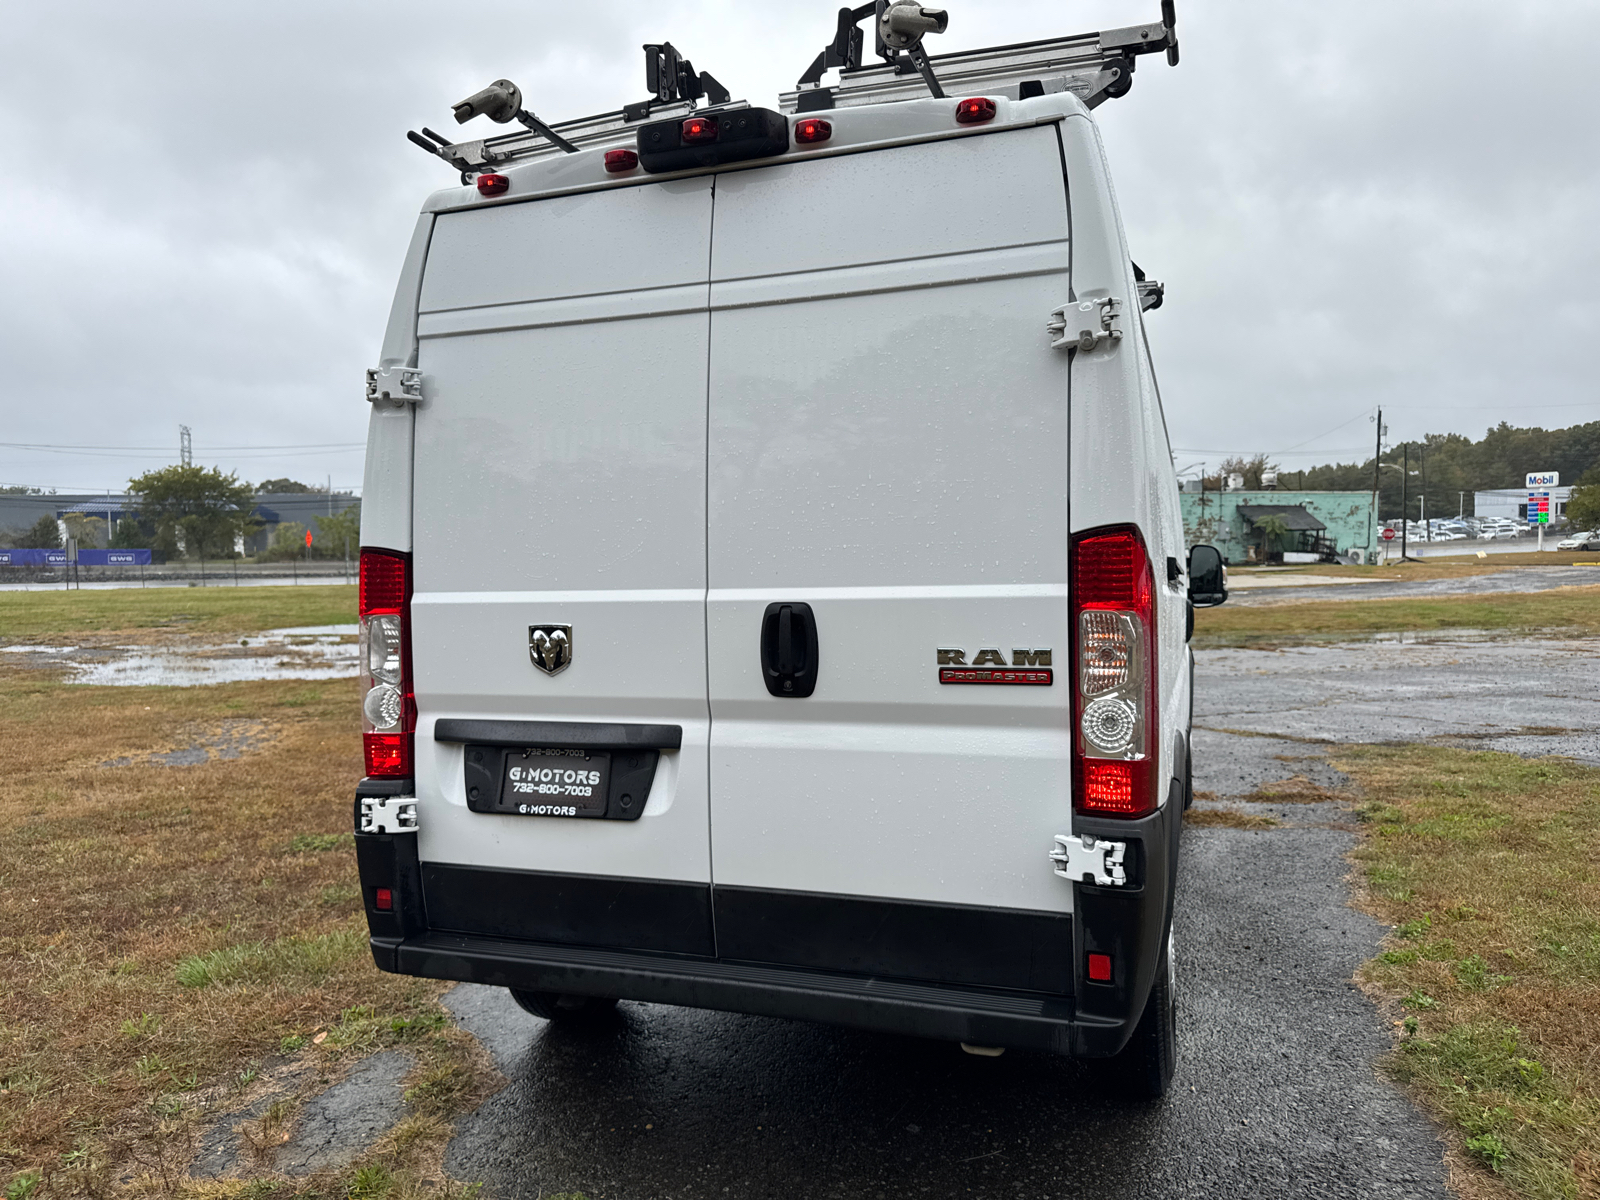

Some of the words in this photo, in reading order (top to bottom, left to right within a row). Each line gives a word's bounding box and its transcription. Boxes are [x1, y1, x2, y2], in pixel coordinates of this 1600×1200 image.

[1528, 475, 1553, 485] Mobil
[937, 647, 1053, 666] RAM
[526, 748, 585, 757] 732-800-7003
[513, 782, 592, 796] 732-800-7003
